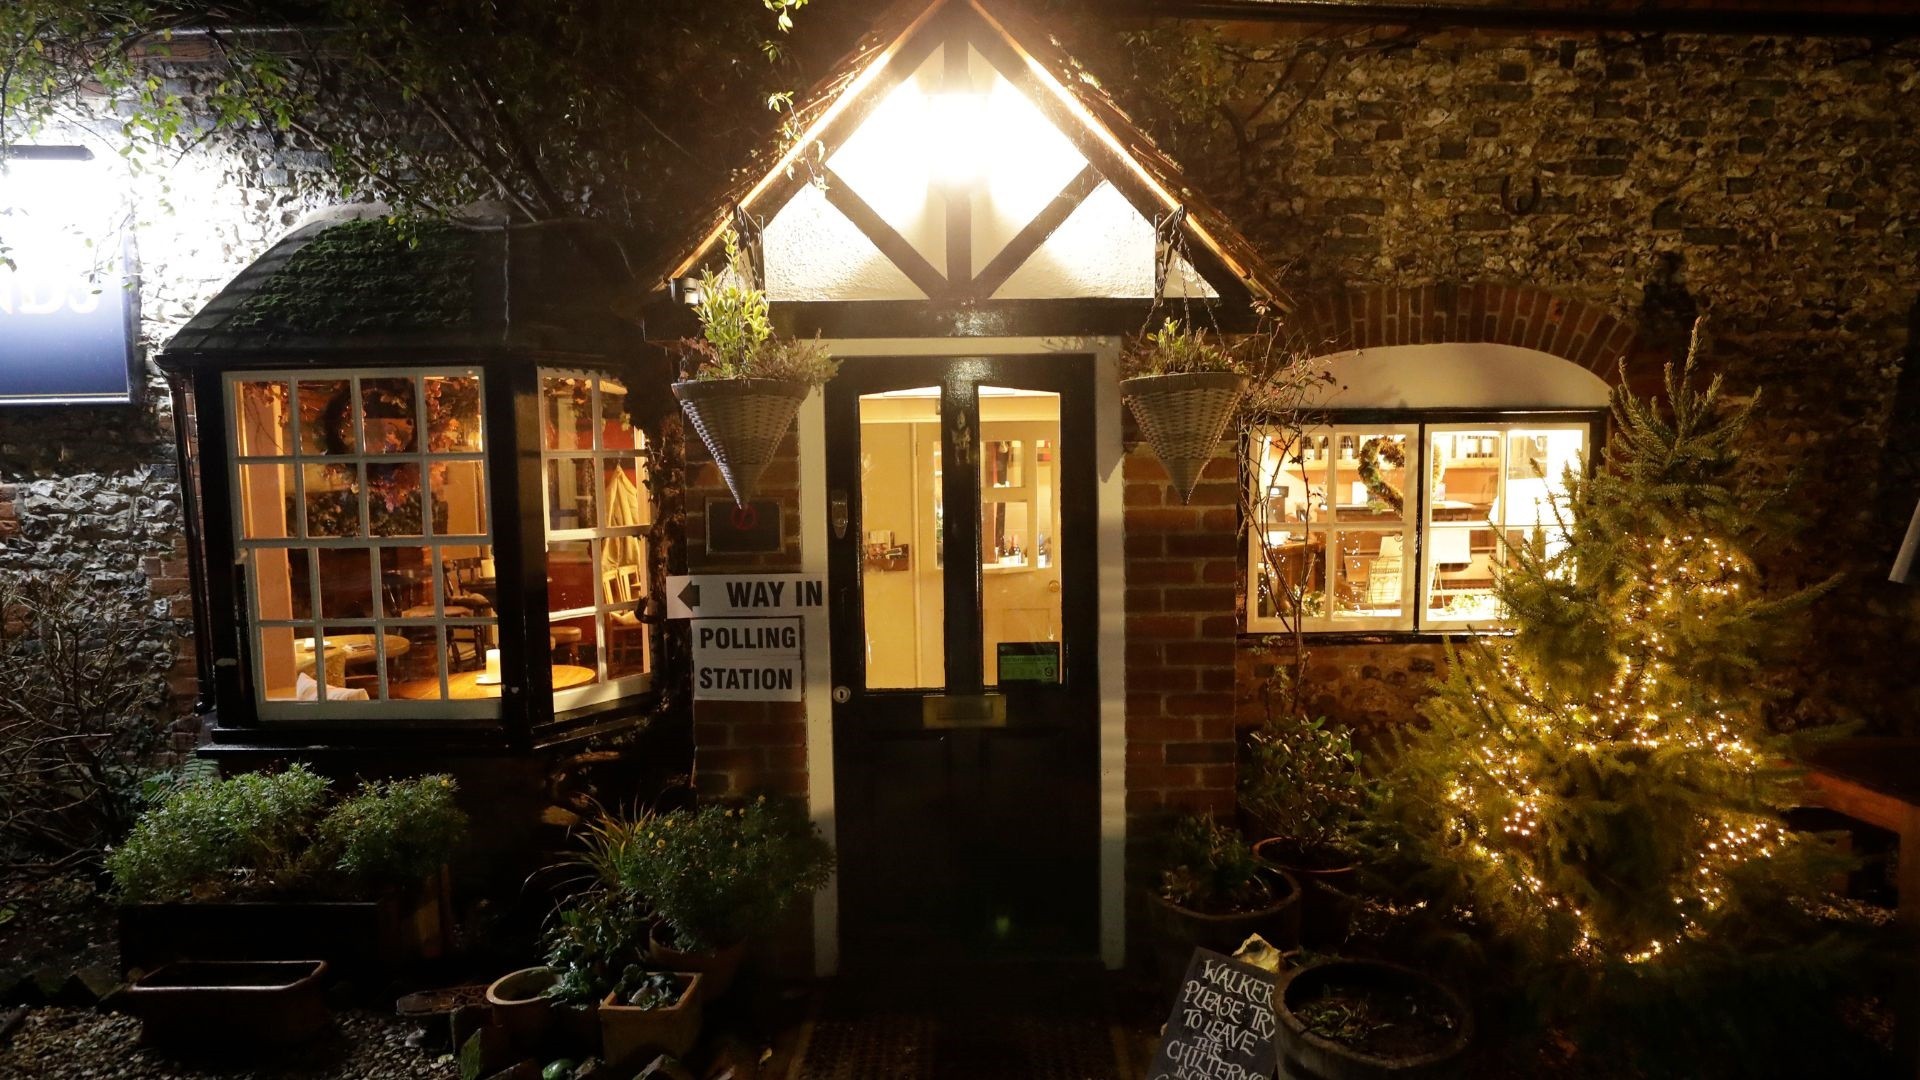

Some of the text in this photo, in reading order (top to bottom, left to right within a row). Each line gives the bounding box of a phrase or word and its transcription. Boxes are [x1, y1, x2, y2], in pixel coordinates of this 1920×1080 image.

[726, 580, 823, 608] WAY IN
[700, 626, 796, 649] POLLING
[699, 667, 793, 690] STATION
[1202, 959, 1275, 1011] WALKER
[1183, 980, 1245, 1024] PLEASE
[1183, 1008, 1259, 1057] TO LEAVE
[1193, 1036, 1224, 1061] THE
